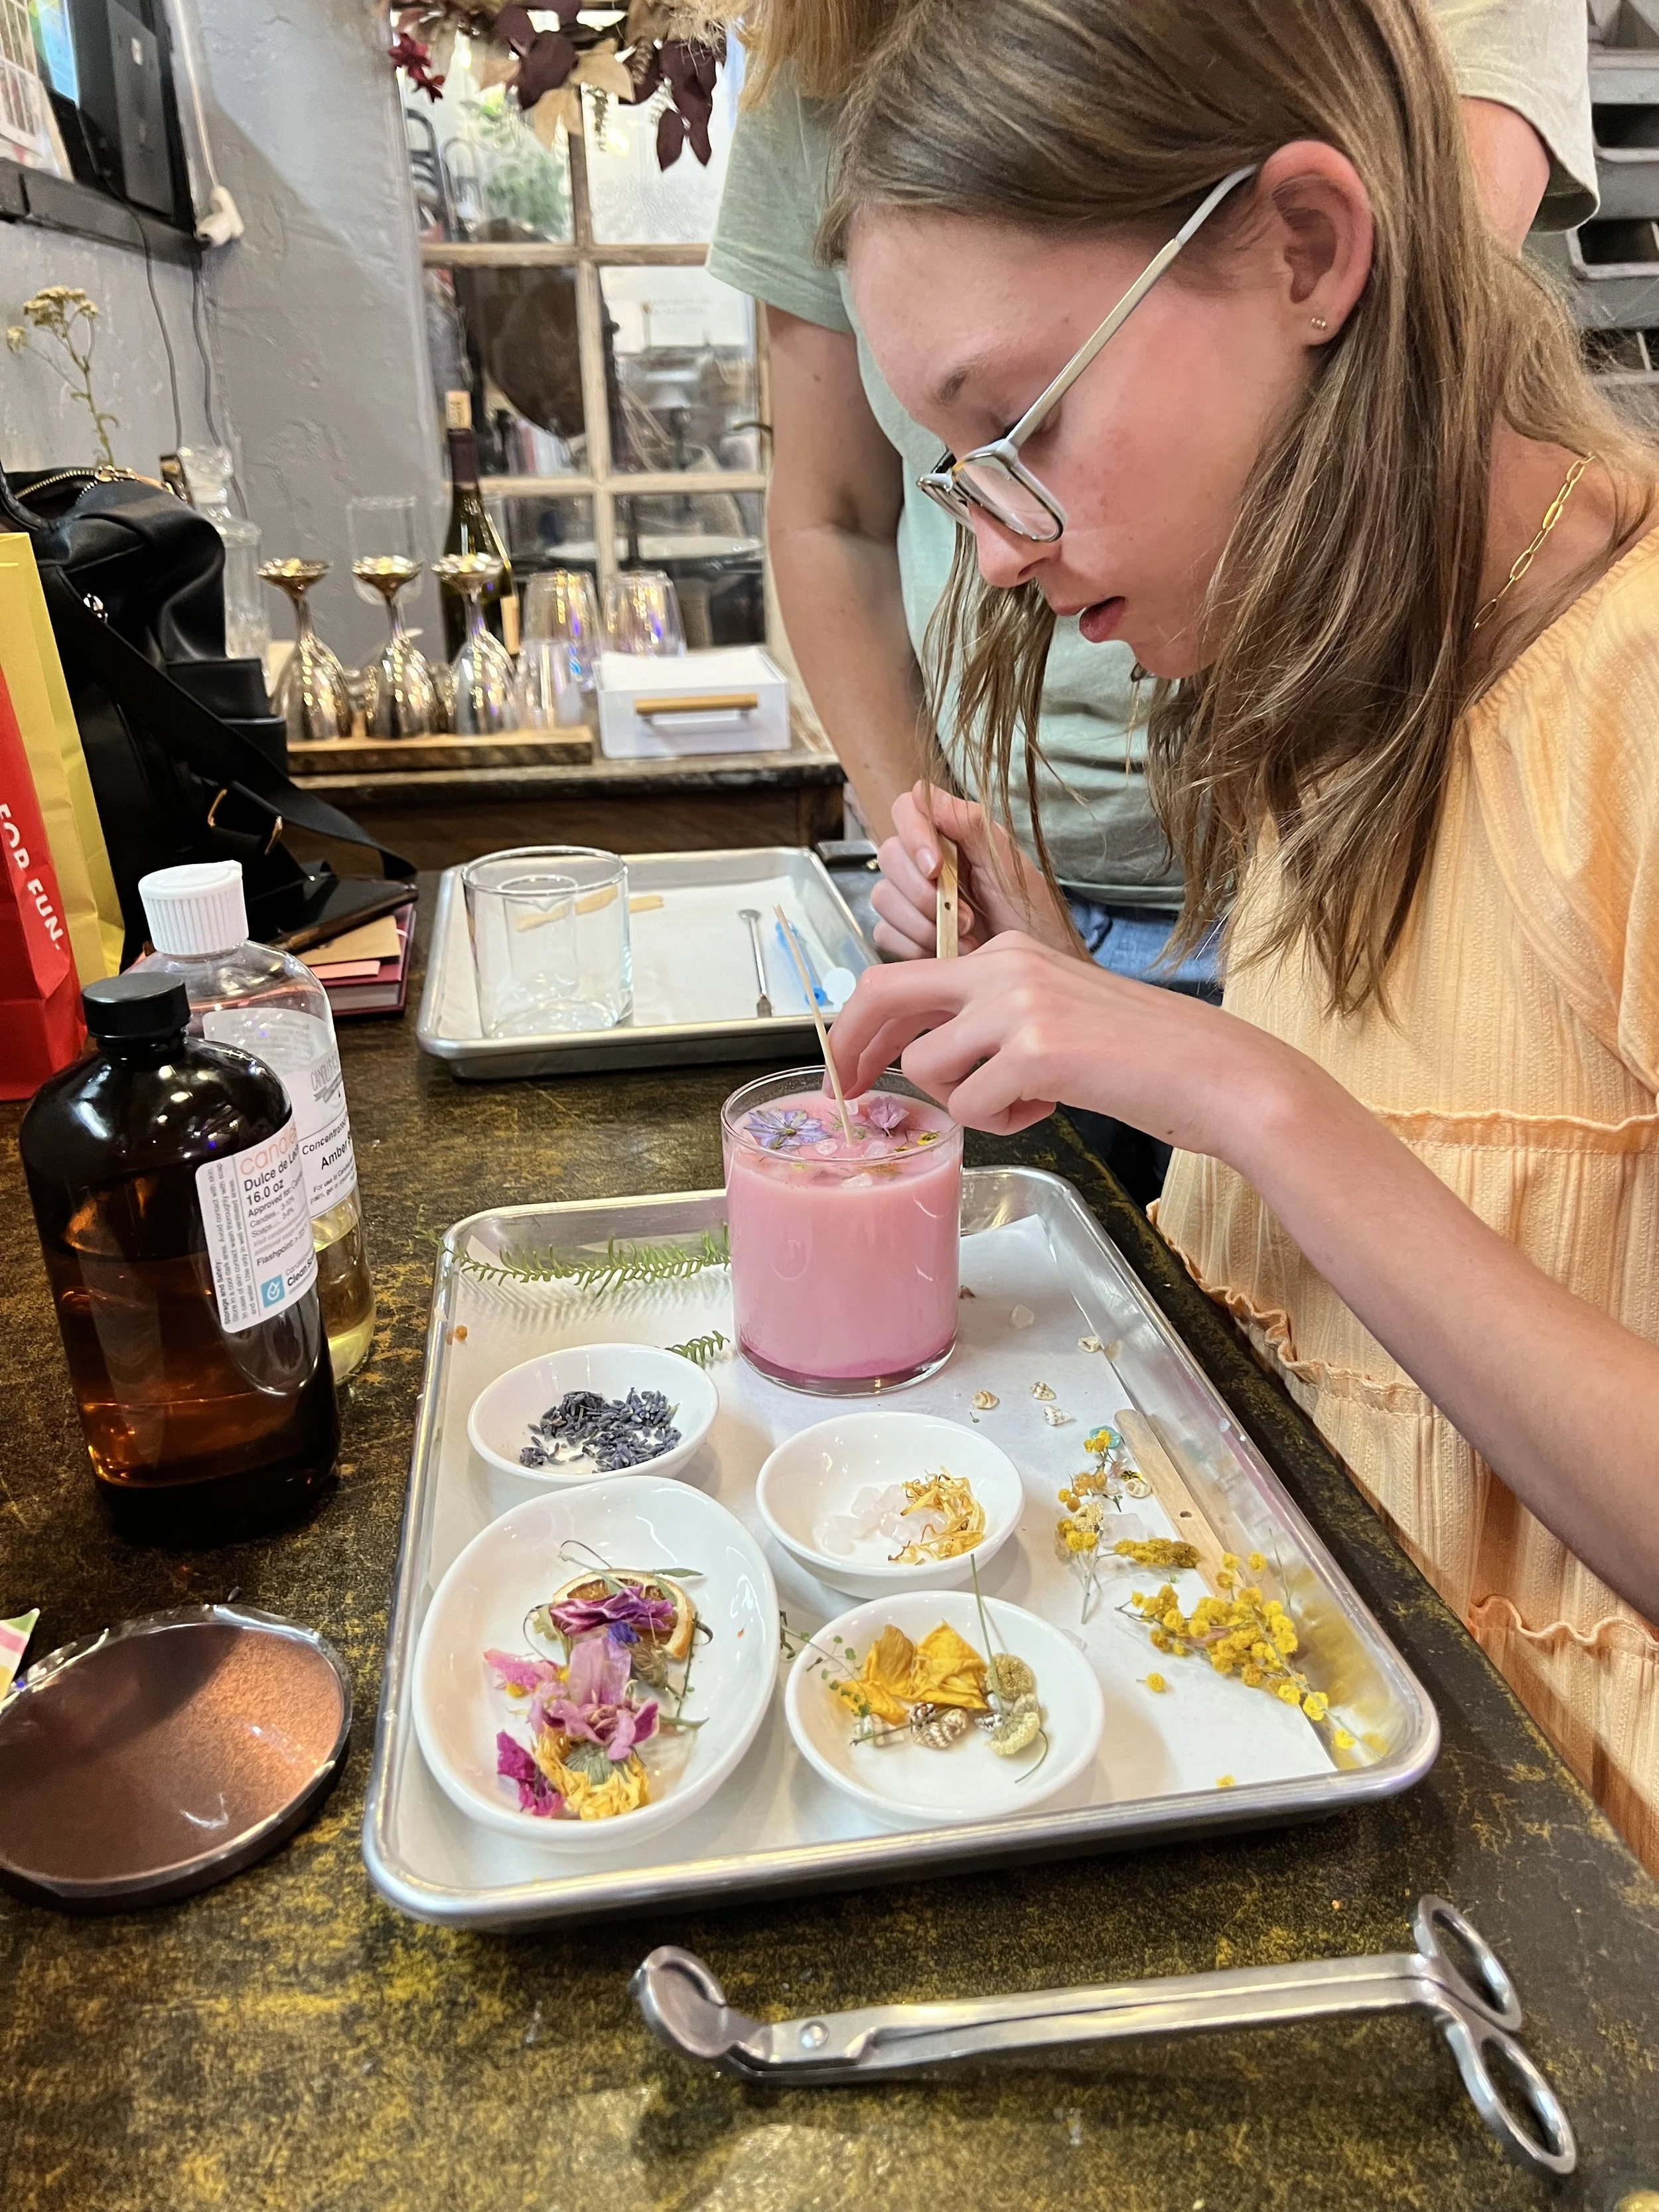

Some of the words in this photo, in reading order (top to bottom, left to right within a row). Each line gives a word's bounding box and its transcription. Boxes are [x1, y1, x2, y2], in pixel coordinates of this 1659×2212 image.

[0, 804, 30, 870] FOR
[27, 878, 64, 950] FUN.
[244, 1169, 276, 1191] Dulce
[278, 1160, 287, 1173] de
[246, 1186, 271, 1206] 16.0
[273, 1179, 284, 1193] oz
